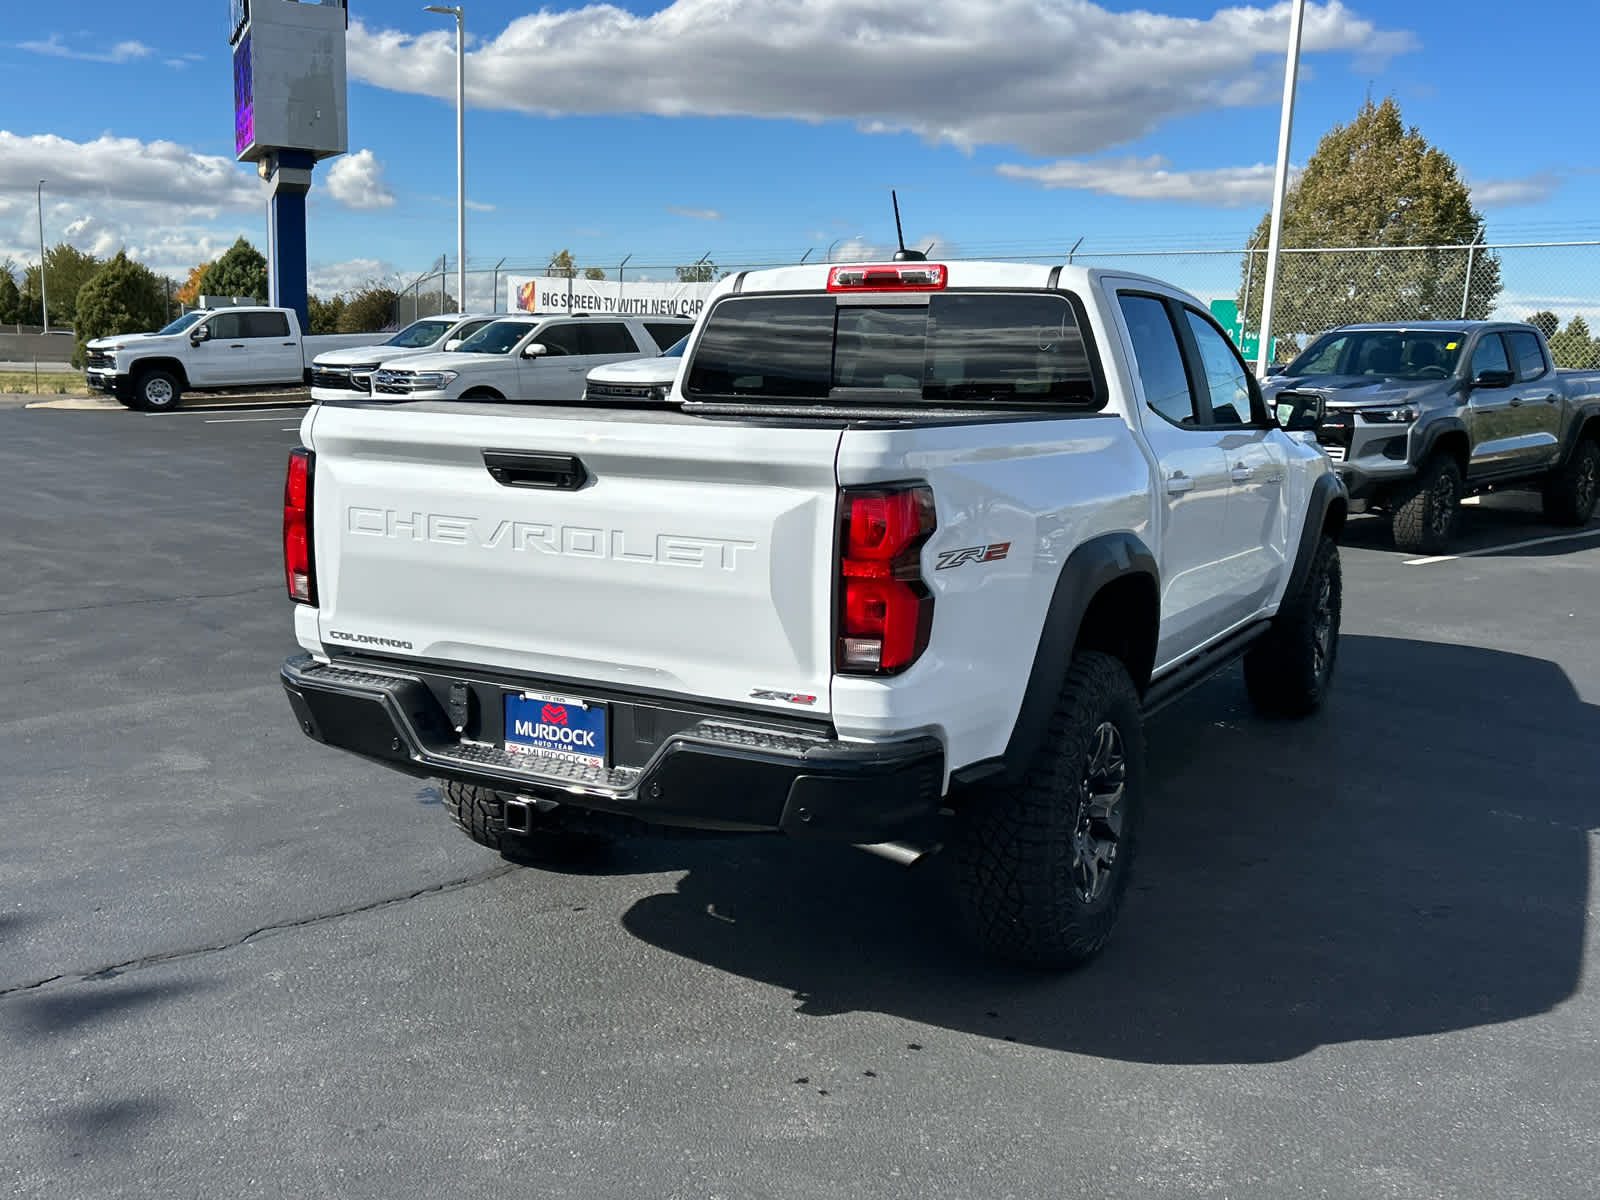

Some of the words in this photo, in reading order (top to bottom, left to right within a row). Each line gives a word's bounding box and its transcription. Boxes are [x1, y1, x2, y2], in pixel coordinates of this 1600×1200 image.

[541, 292, 558, 307] BIG
[561, 293, 601, 311] SCREEN
[604, 297, 617, 312] TV
[617, 298, 648, 314] WITH
[651, 299, 679, 315] NEW
[346, 505, 759, 572] CHEVROLET
[935, 542, 1011, 571] ZR2
[329, 630, 413, 650] COLORADO
[748, 688, 818, 706] ZR2
[515, 719, 595, 748] MURDOCK
[533, 740, 552, 748] AUTO
[554, 742, 573, 751] TEAM
